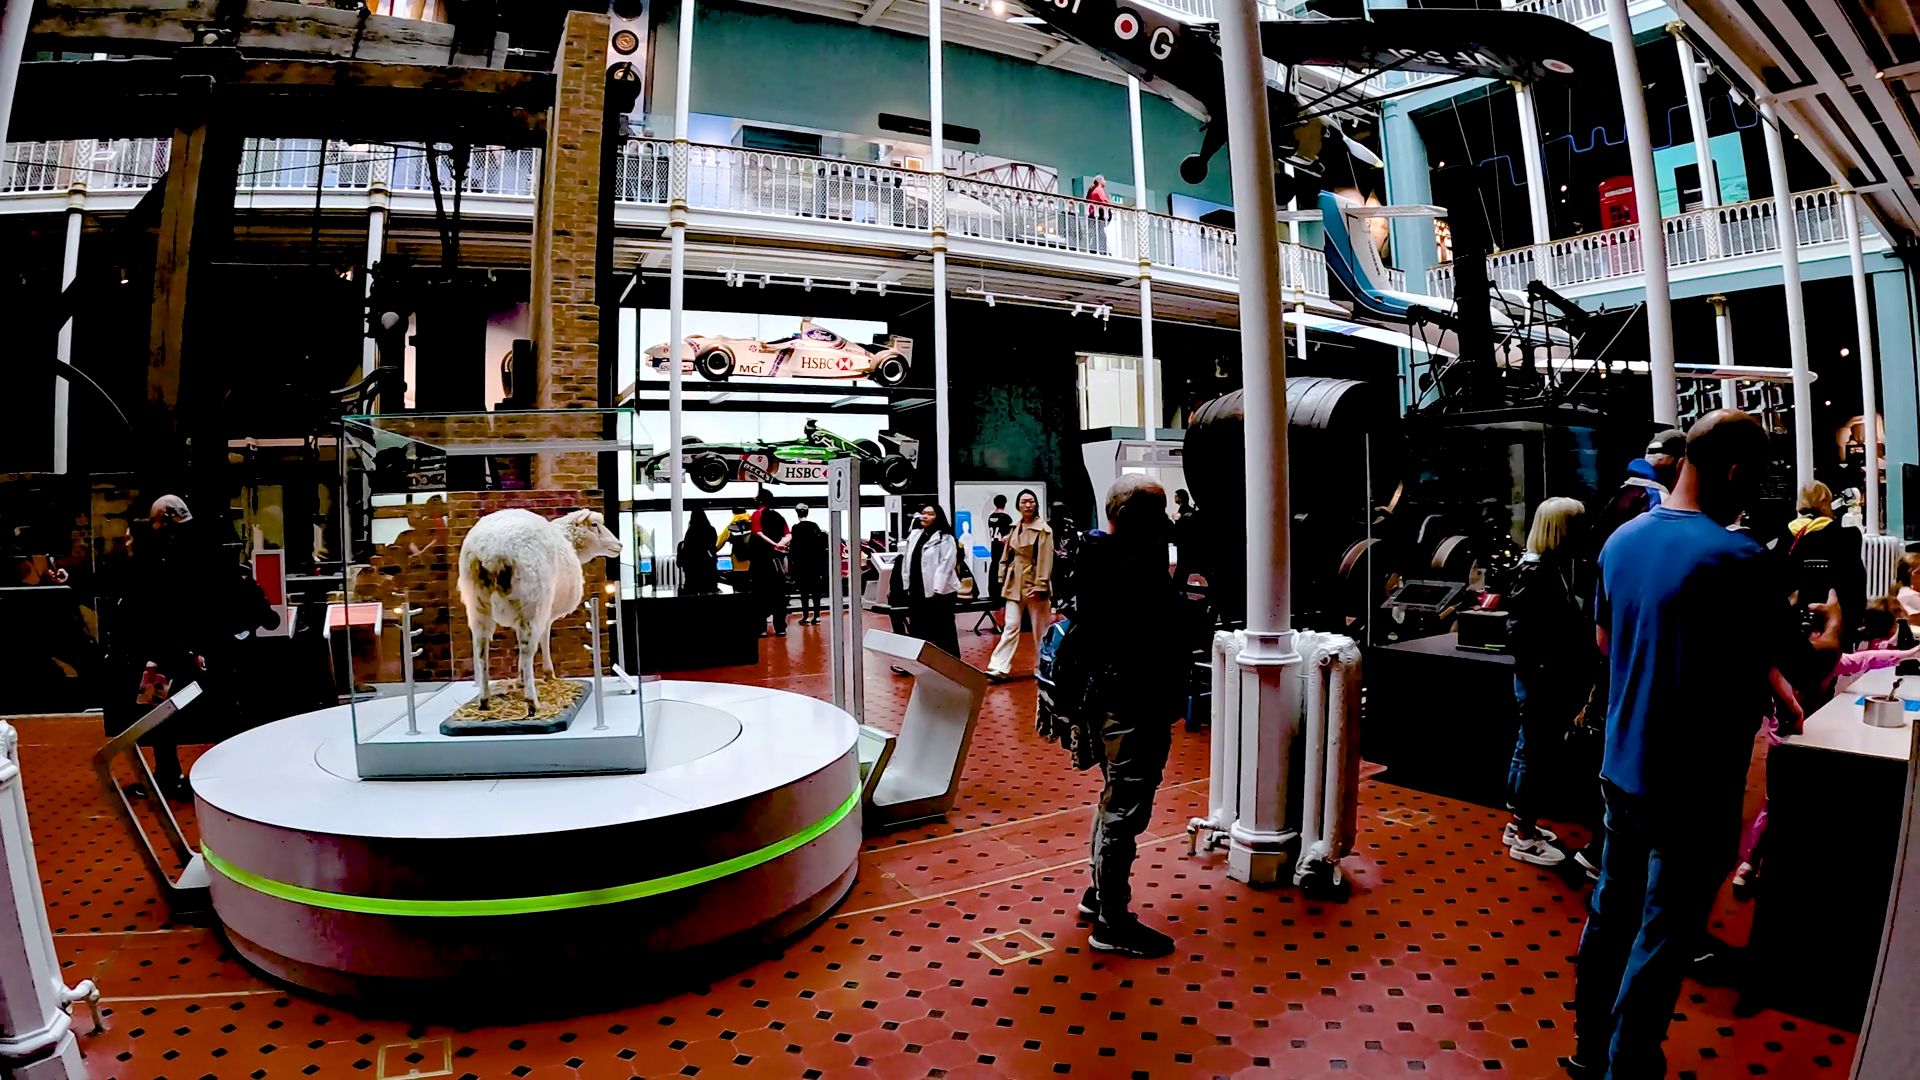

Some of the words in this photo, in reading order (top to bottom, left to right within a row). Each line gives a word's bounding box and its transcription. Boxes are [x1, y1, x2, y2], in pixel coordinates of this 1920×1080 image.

[1150, 27, 1174, 60] G
[811, 329, 833, 342] Ford
[739, 364, 763, 374] MCI
[801, 356, 835, 370] HSBC
[785, 467, 821, 479] HSBC
